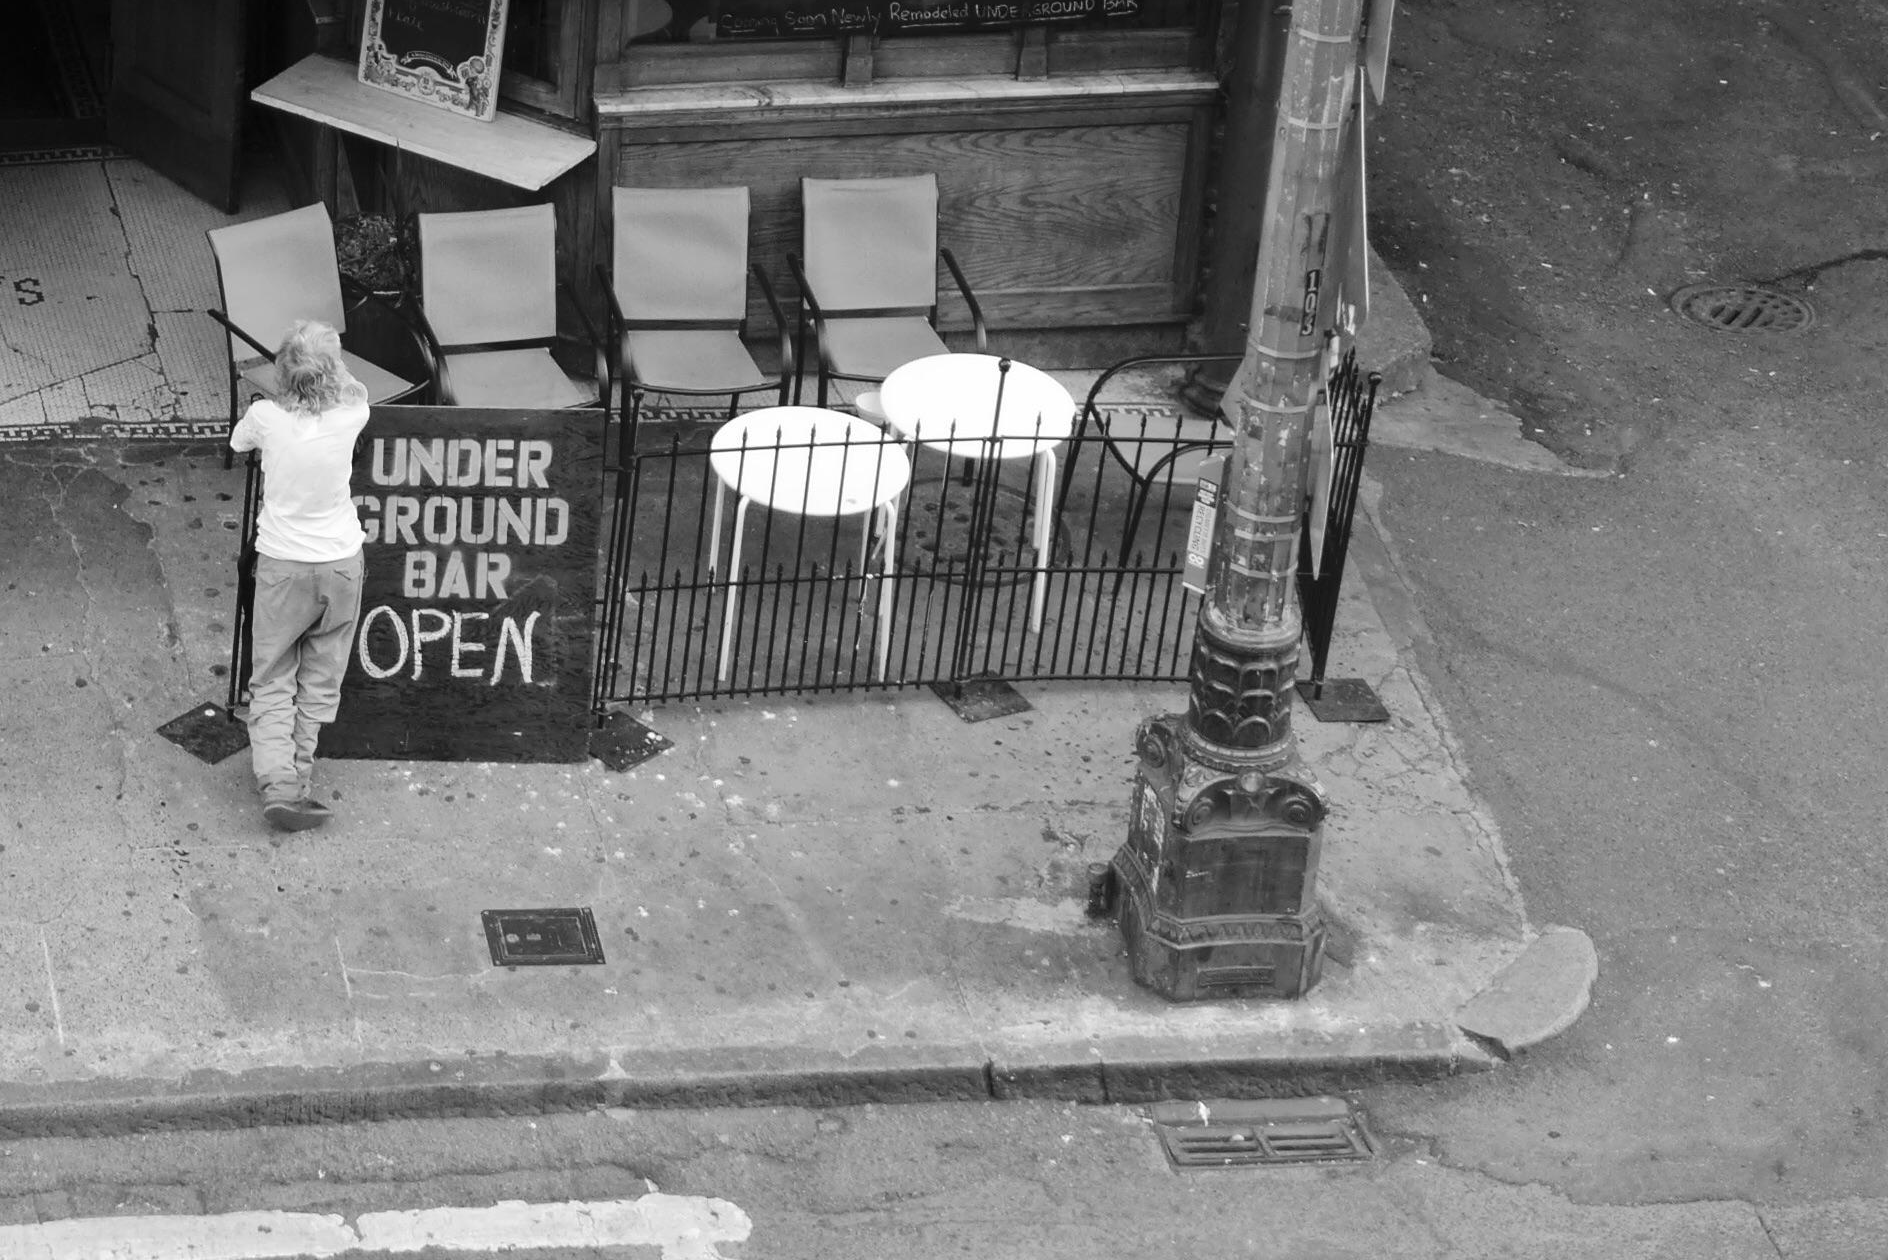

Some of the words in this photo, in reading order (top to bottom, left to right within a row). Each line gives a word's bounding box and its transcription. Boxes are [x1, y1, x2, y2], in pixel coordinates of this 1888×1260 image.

[831, 6, 881, 37] Newly
[890, 1, 969, 22] Remodeled
[371, 438, 554, 489] UNDER
[354, 495, 570, 547] GROUND
[403, 550, 512, 600] BAR
[358, 605, 542, 687] OPEN
